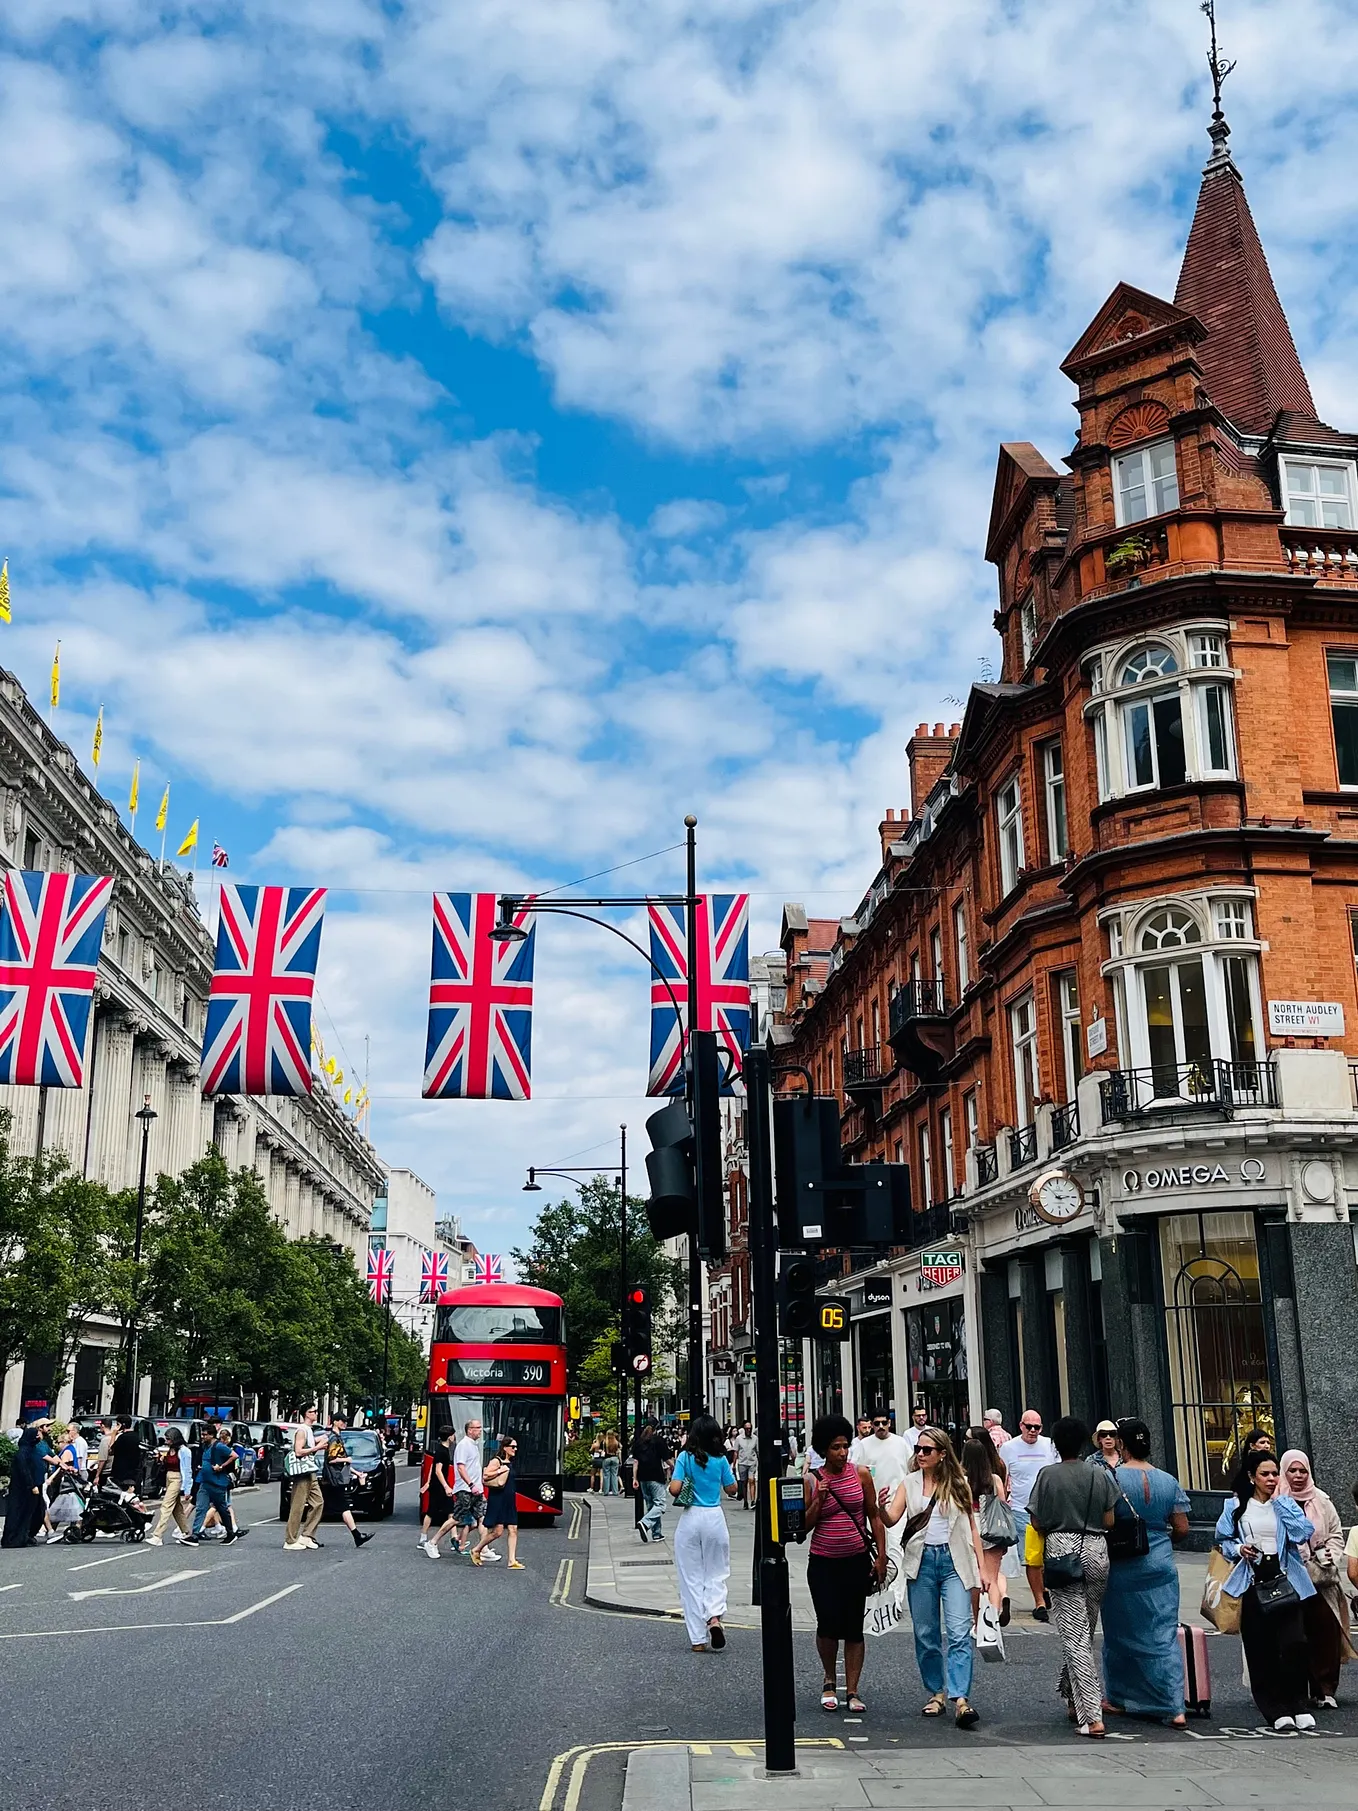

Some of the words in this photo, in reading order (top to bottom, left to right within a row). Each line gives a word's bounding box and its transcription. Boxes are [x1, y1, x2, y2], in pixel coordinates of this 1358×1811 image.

[1274, 1004, 1303, 1014] NORTH
[1306, 1005, 1338, 1015] AUDLEY
[1275, 1015, 1305, 1024] STREET
[1308, 1016, 1320, 1024] W1
[1145, 1163, 1230, 1189] OMEGA
[923, 1254, 958, 1266] TAG
[923, 1267, 960, 1285] HEUER
[867, 1293, 890, 1303] dyson
[822, 1308, 843, 1328] 05
[463, 1367, 504, 1378] Victoria
[522, 1365, 543, 1381] 390
